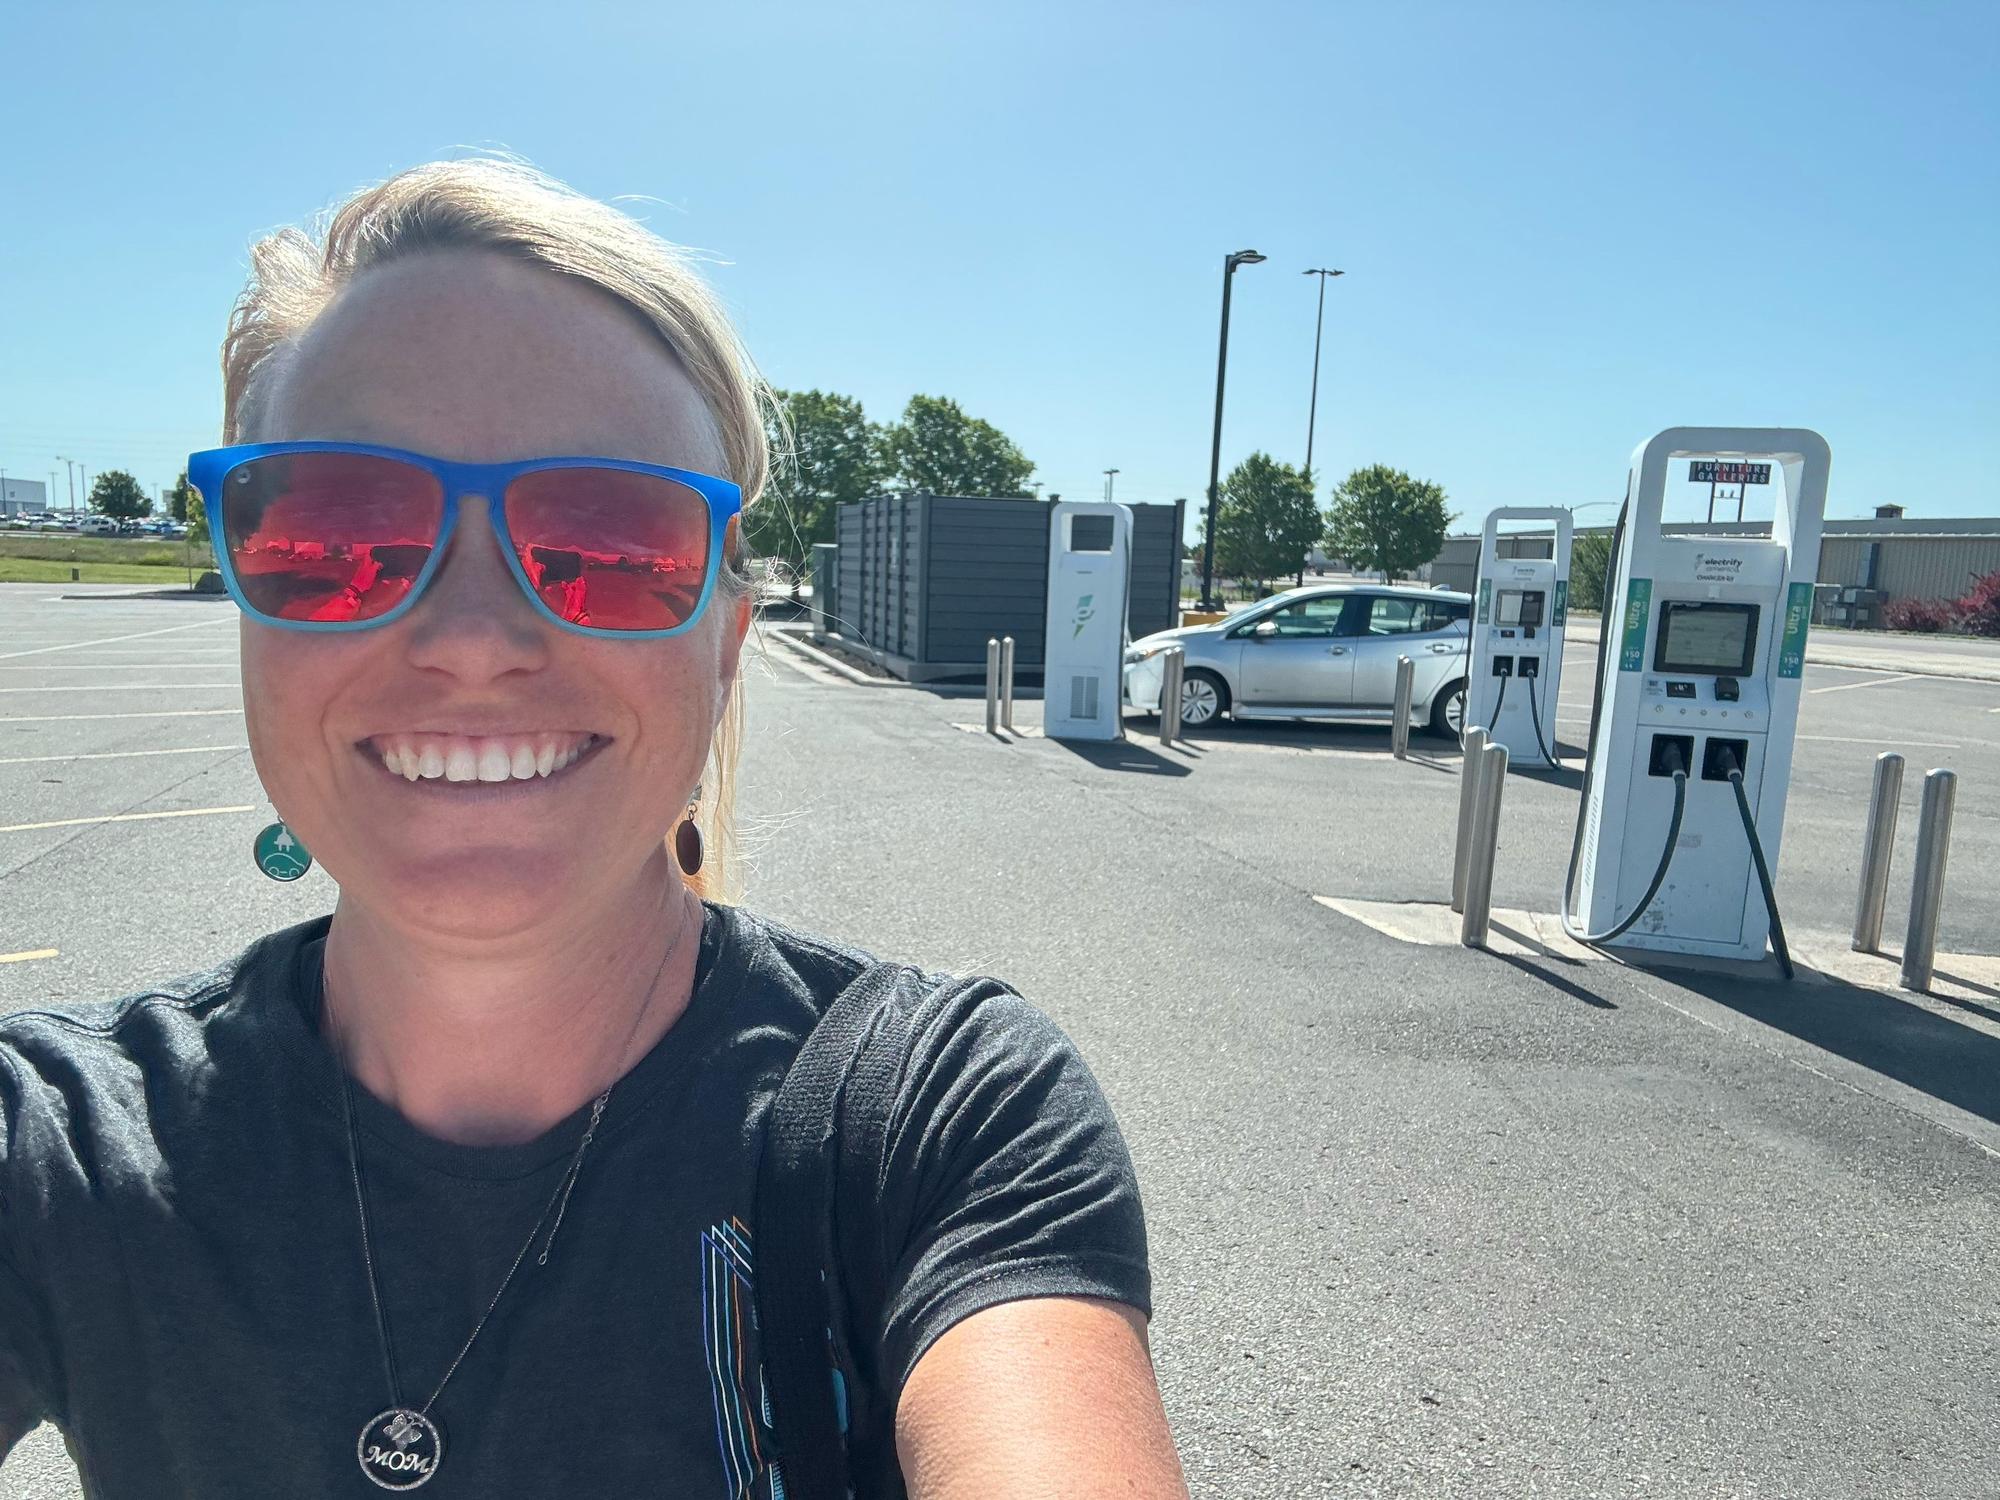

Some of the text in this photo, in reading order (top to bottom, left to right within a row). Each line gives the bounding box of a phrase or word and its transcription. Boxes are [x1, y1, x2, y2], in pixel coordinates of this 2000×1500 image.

[1697, 463, 1768, 474] FURNITURE
[1698, 472, 1766, 483] GALLERIES
[1705, 559, 1743, 568] electrify
[1629, 600, 1642, 630] Ultra
[1787, 605, 1801, 634] Ultra
[1625, 650, 1640, 658] 150
[365, 1445, 431, 1474] MOM
